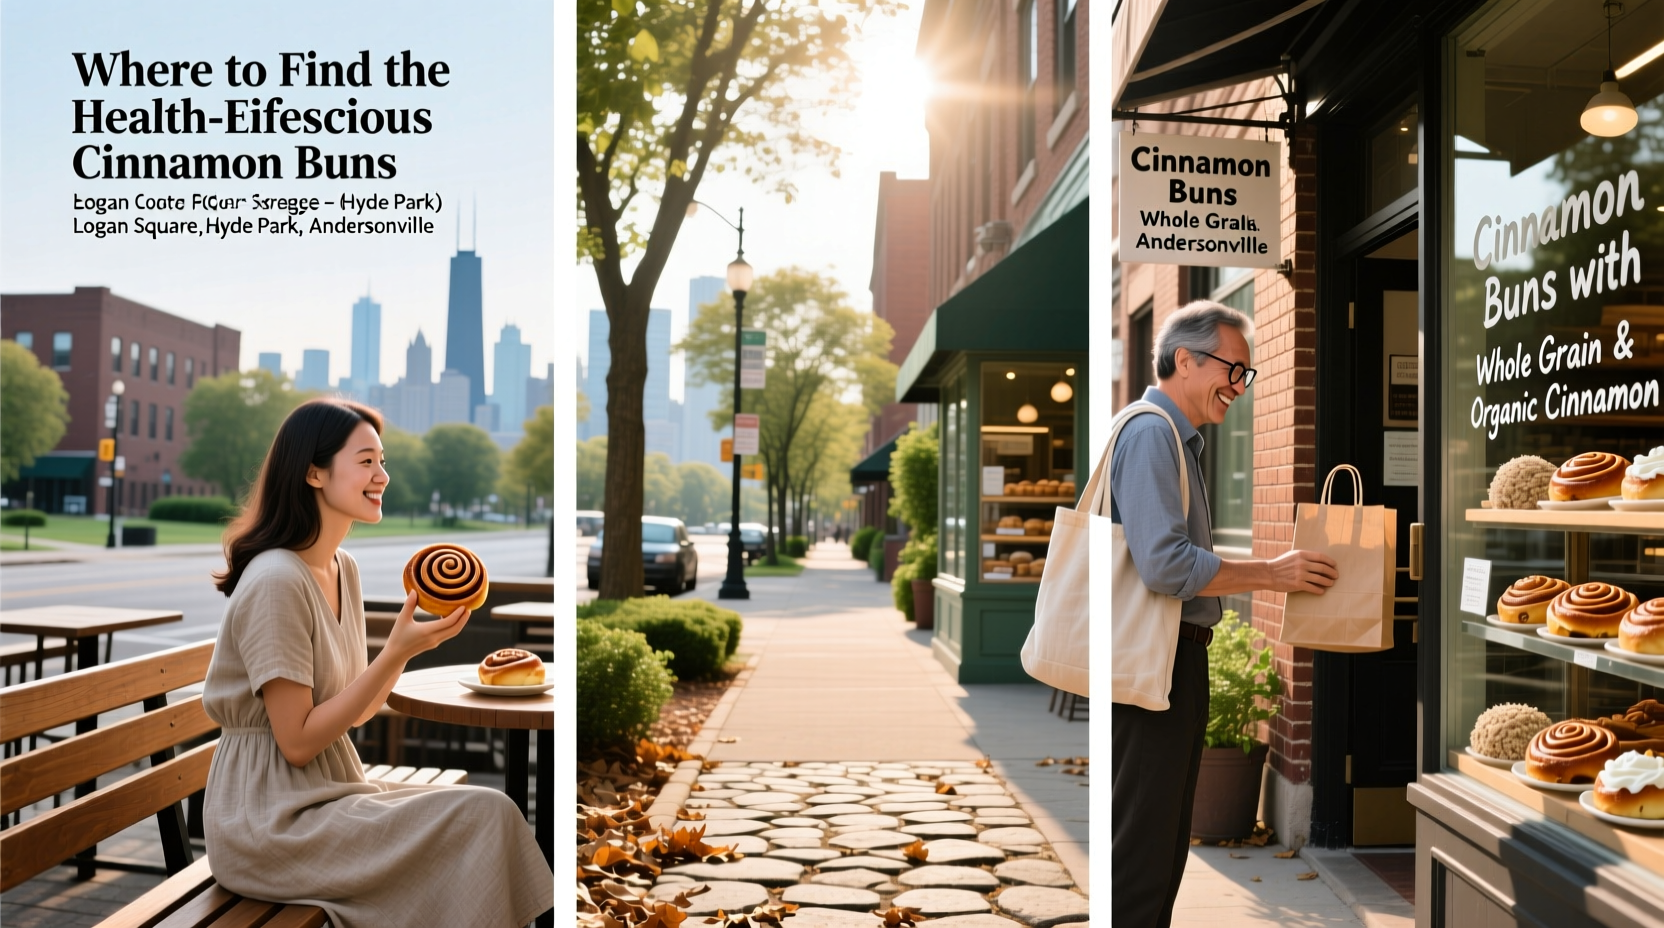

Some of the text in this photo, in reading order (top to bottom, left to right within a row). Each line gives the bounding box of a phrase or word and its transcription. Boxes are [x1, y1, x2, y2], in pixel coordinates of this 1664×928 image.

[1131, 146, 1271, 177] Cinnamon
[1169, 178, 1237, 206] Buns
[1140, 210, 1200, 228] Whole
[1473, 169, 1645, 271] Cinnamon
[1483, 229, 1641, 329] Buns with
[1476, 320, 1634, 386] Whole Grain &
[1471, 391, 1538, 440] Organic
[1545, 379, 1659, 420] Cinnamon
